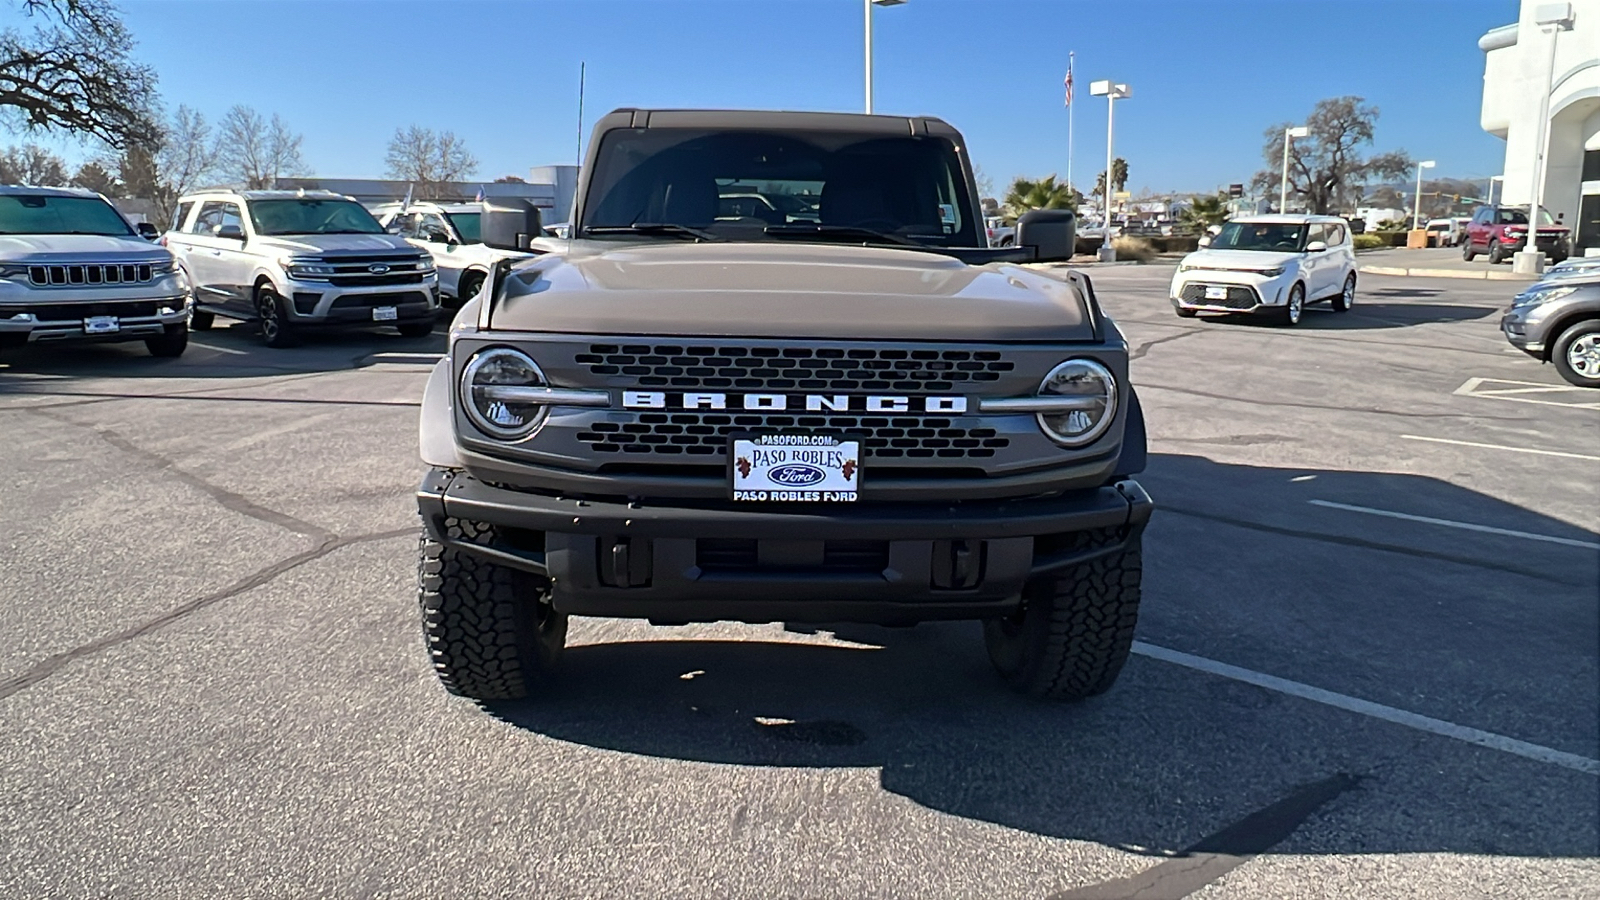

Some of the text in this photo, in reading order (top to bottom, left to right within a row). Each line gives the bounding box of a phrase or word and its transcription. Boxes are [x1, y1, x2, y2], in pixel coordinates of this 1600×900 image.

[622, 391, 967, 412] BRONCO
[761, 435, 832, 446] PASOFORD.COM
[753, 449, 843, 469] PASO ROBLES
[780, 467, 815, 482] Ford
[733, 491, 767, 501] PASO
[770, 491, 820, 501] ROBLES
